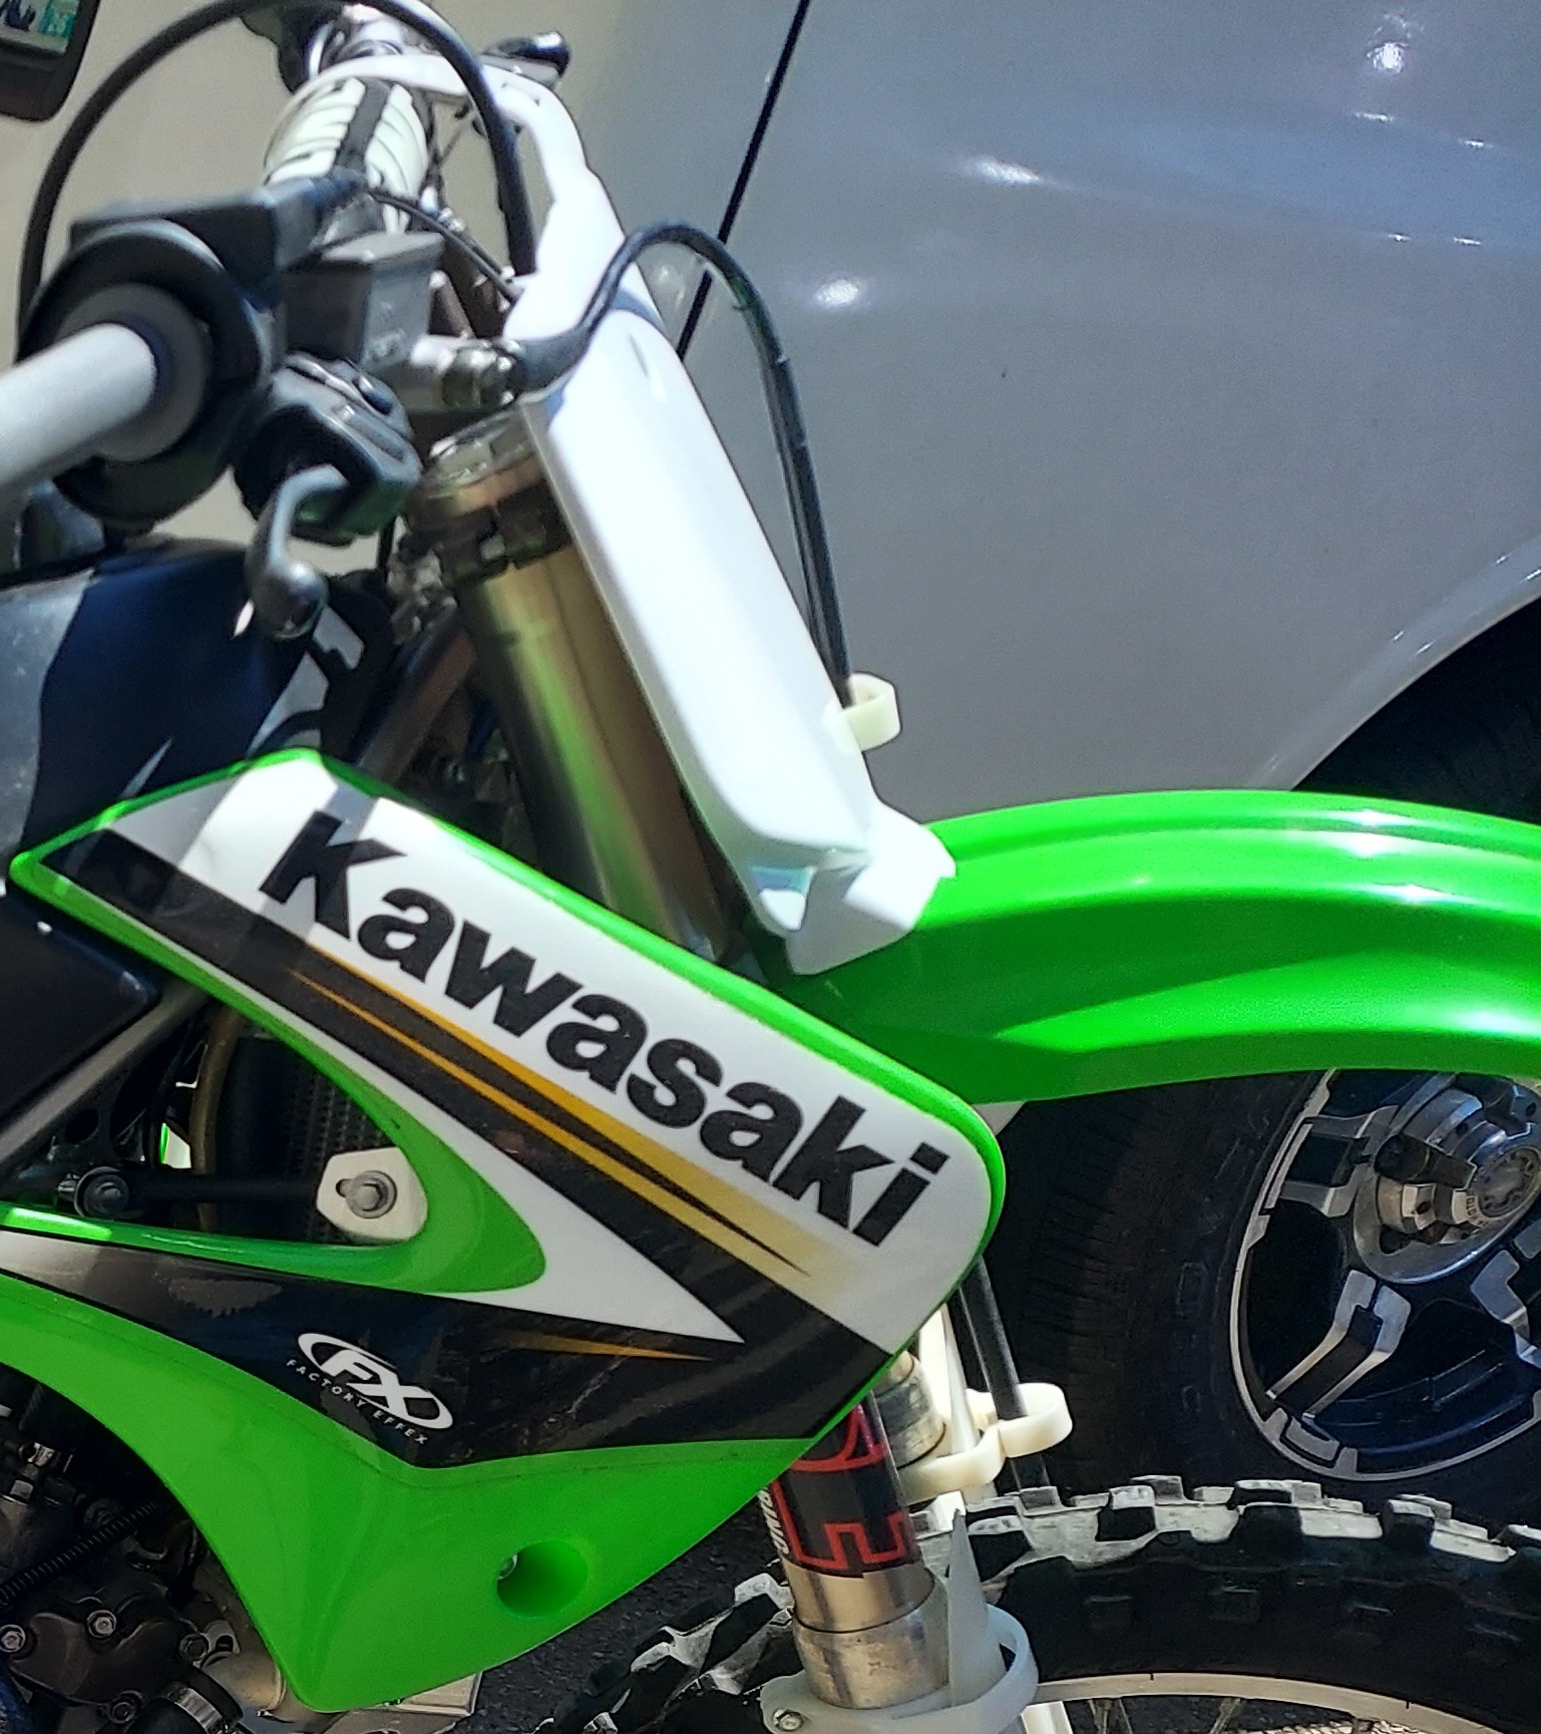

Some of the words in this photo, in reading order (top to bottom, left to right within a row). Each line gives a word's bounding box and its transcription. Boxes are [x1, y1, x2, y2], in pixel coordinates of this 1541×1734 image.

[259, 810, 950, 1247] Kawasaki
[286, 1359, 367, 1408] FACTORY
[373, 1410, 428, 1444] EFFEX
